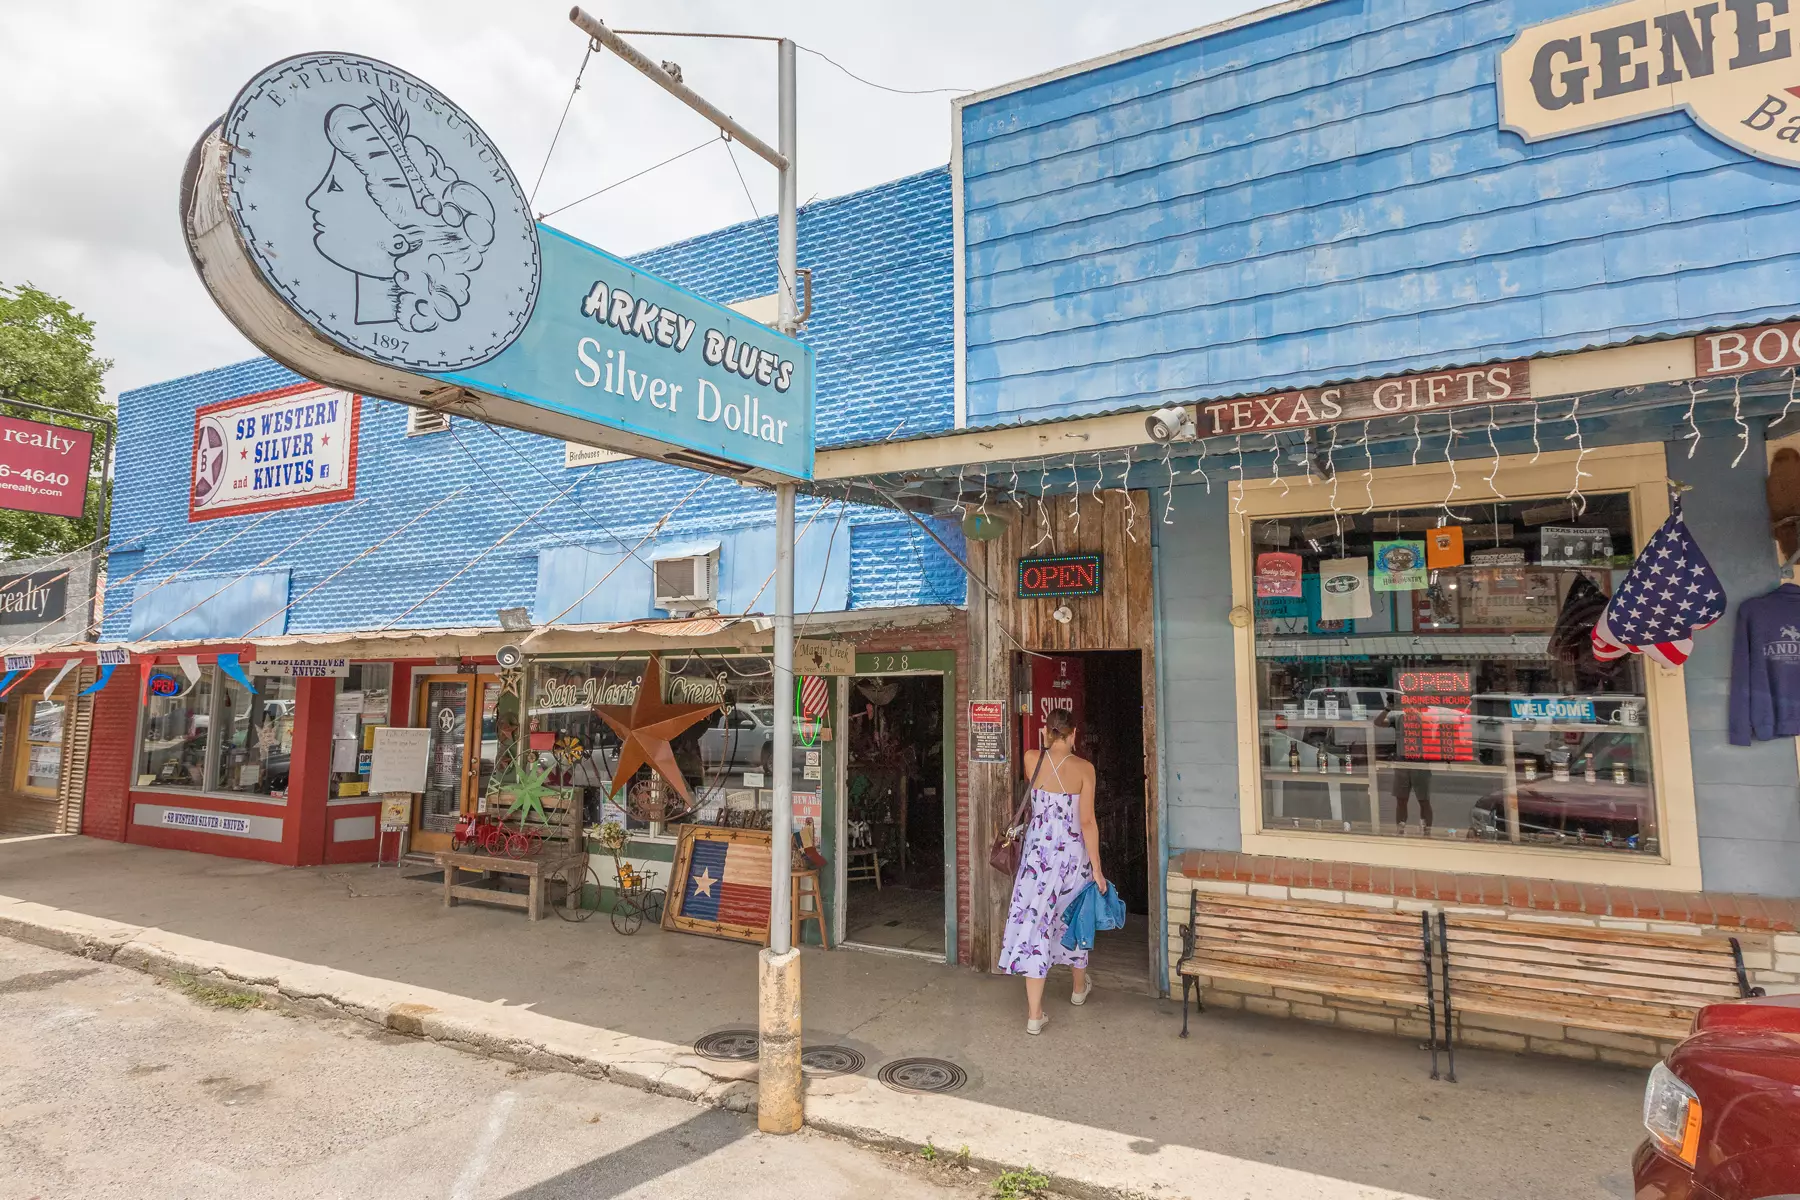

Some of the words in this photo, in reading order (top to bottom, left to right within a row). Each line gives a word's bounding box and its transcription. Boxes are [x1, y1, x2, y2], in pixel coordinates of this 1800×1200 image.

[266, 90, 286, 108] E
[297, 66, 434, 113] PLURIBUS
[446, 114, 506, 184] UNUM
[379, 123, 423, 194] LIBERTY
[371, 332, 410, 354] 1897
[580, 280, 697, 354] ARKEY
[702, 327, 795, 394] BLUE'S
[574, 336, 684, 413] Silver
[696, 377, 788, 446] Dollar
[1204, 389, 1344, 434] TEXAS
[1372, 366, 1513, 412] GIFTS
[235, 416, 256, 441] SB
[261, 399, 339, 436] WESTERN
[3, 428, 77, 455] realty
[254, 432, 314, 464] SILVER
[569, 440, 600, 461] Birdhouses
[233, 476, 248, 490] and
[253, 459, 314, 491] KNIVES
[1023, 563, 1096, 589] OPEN
[7, 655, 33, 669] JEWELRY
[100, 650, 126, 664] KNIVES
[800, 644, 828, 657] Martin
[829, 645, 851, 663] Creek
[873, 655, 908, 671] 328
[292, 667, 326, 676] KNIVES
[1400, 672, 1470, 692] OPEN
[540, 678, 577, 708] San
[583, 676, 641, 709] Marti
[1401, 695, 1441, 705] BUSINESS
[1442, 695, 1472, 705] HOURS
[1514, 703, 1592, 718] WELCOME
[803, 806, 812, 815] OF
[175, 813, 198, 826] WESTERN
[223, 819, 245, 831] KNIVES
